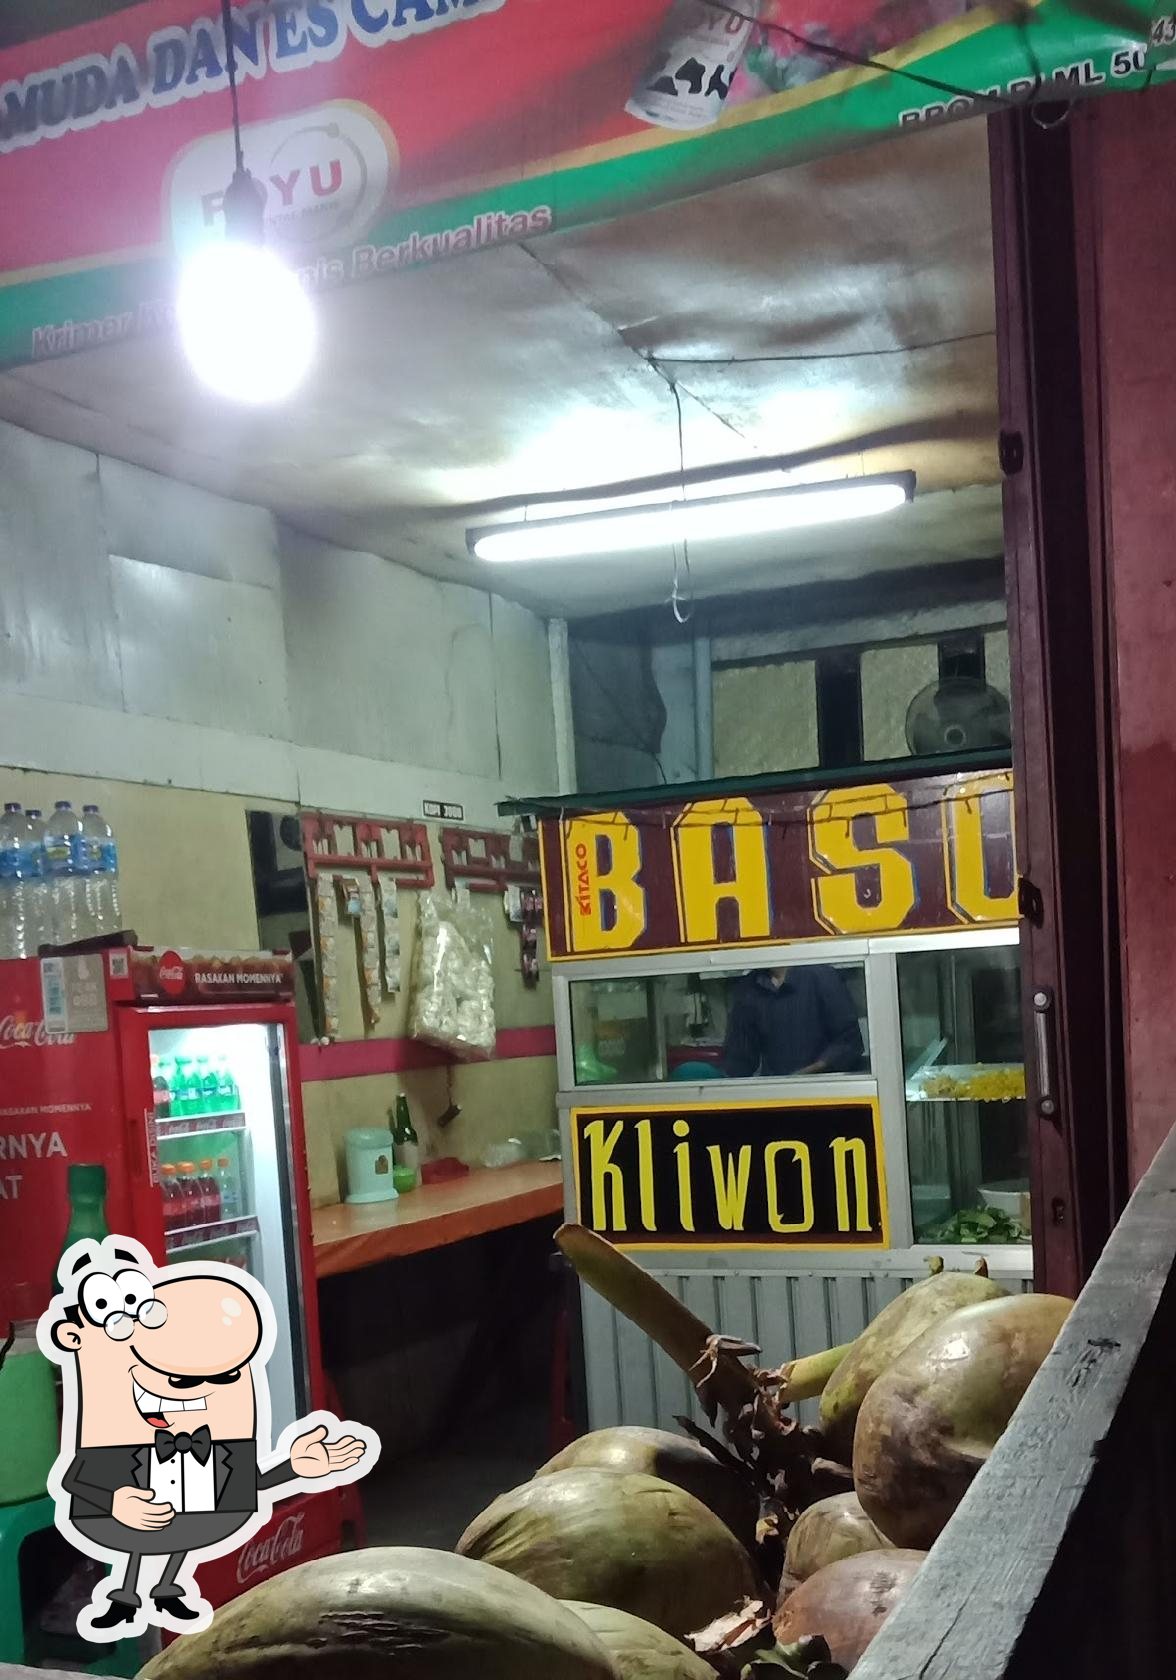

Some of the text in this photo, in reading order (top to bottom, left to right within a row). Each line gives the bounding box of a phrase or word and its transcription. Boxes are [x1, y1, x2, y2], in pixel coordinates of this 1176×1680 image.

[275, 0, 339, 58] ES
[351, 204, 553, 278] Berkualitas
[574, 842, 592, 916] KITACO
[583, 1119, 872, 1232] Kliwon
